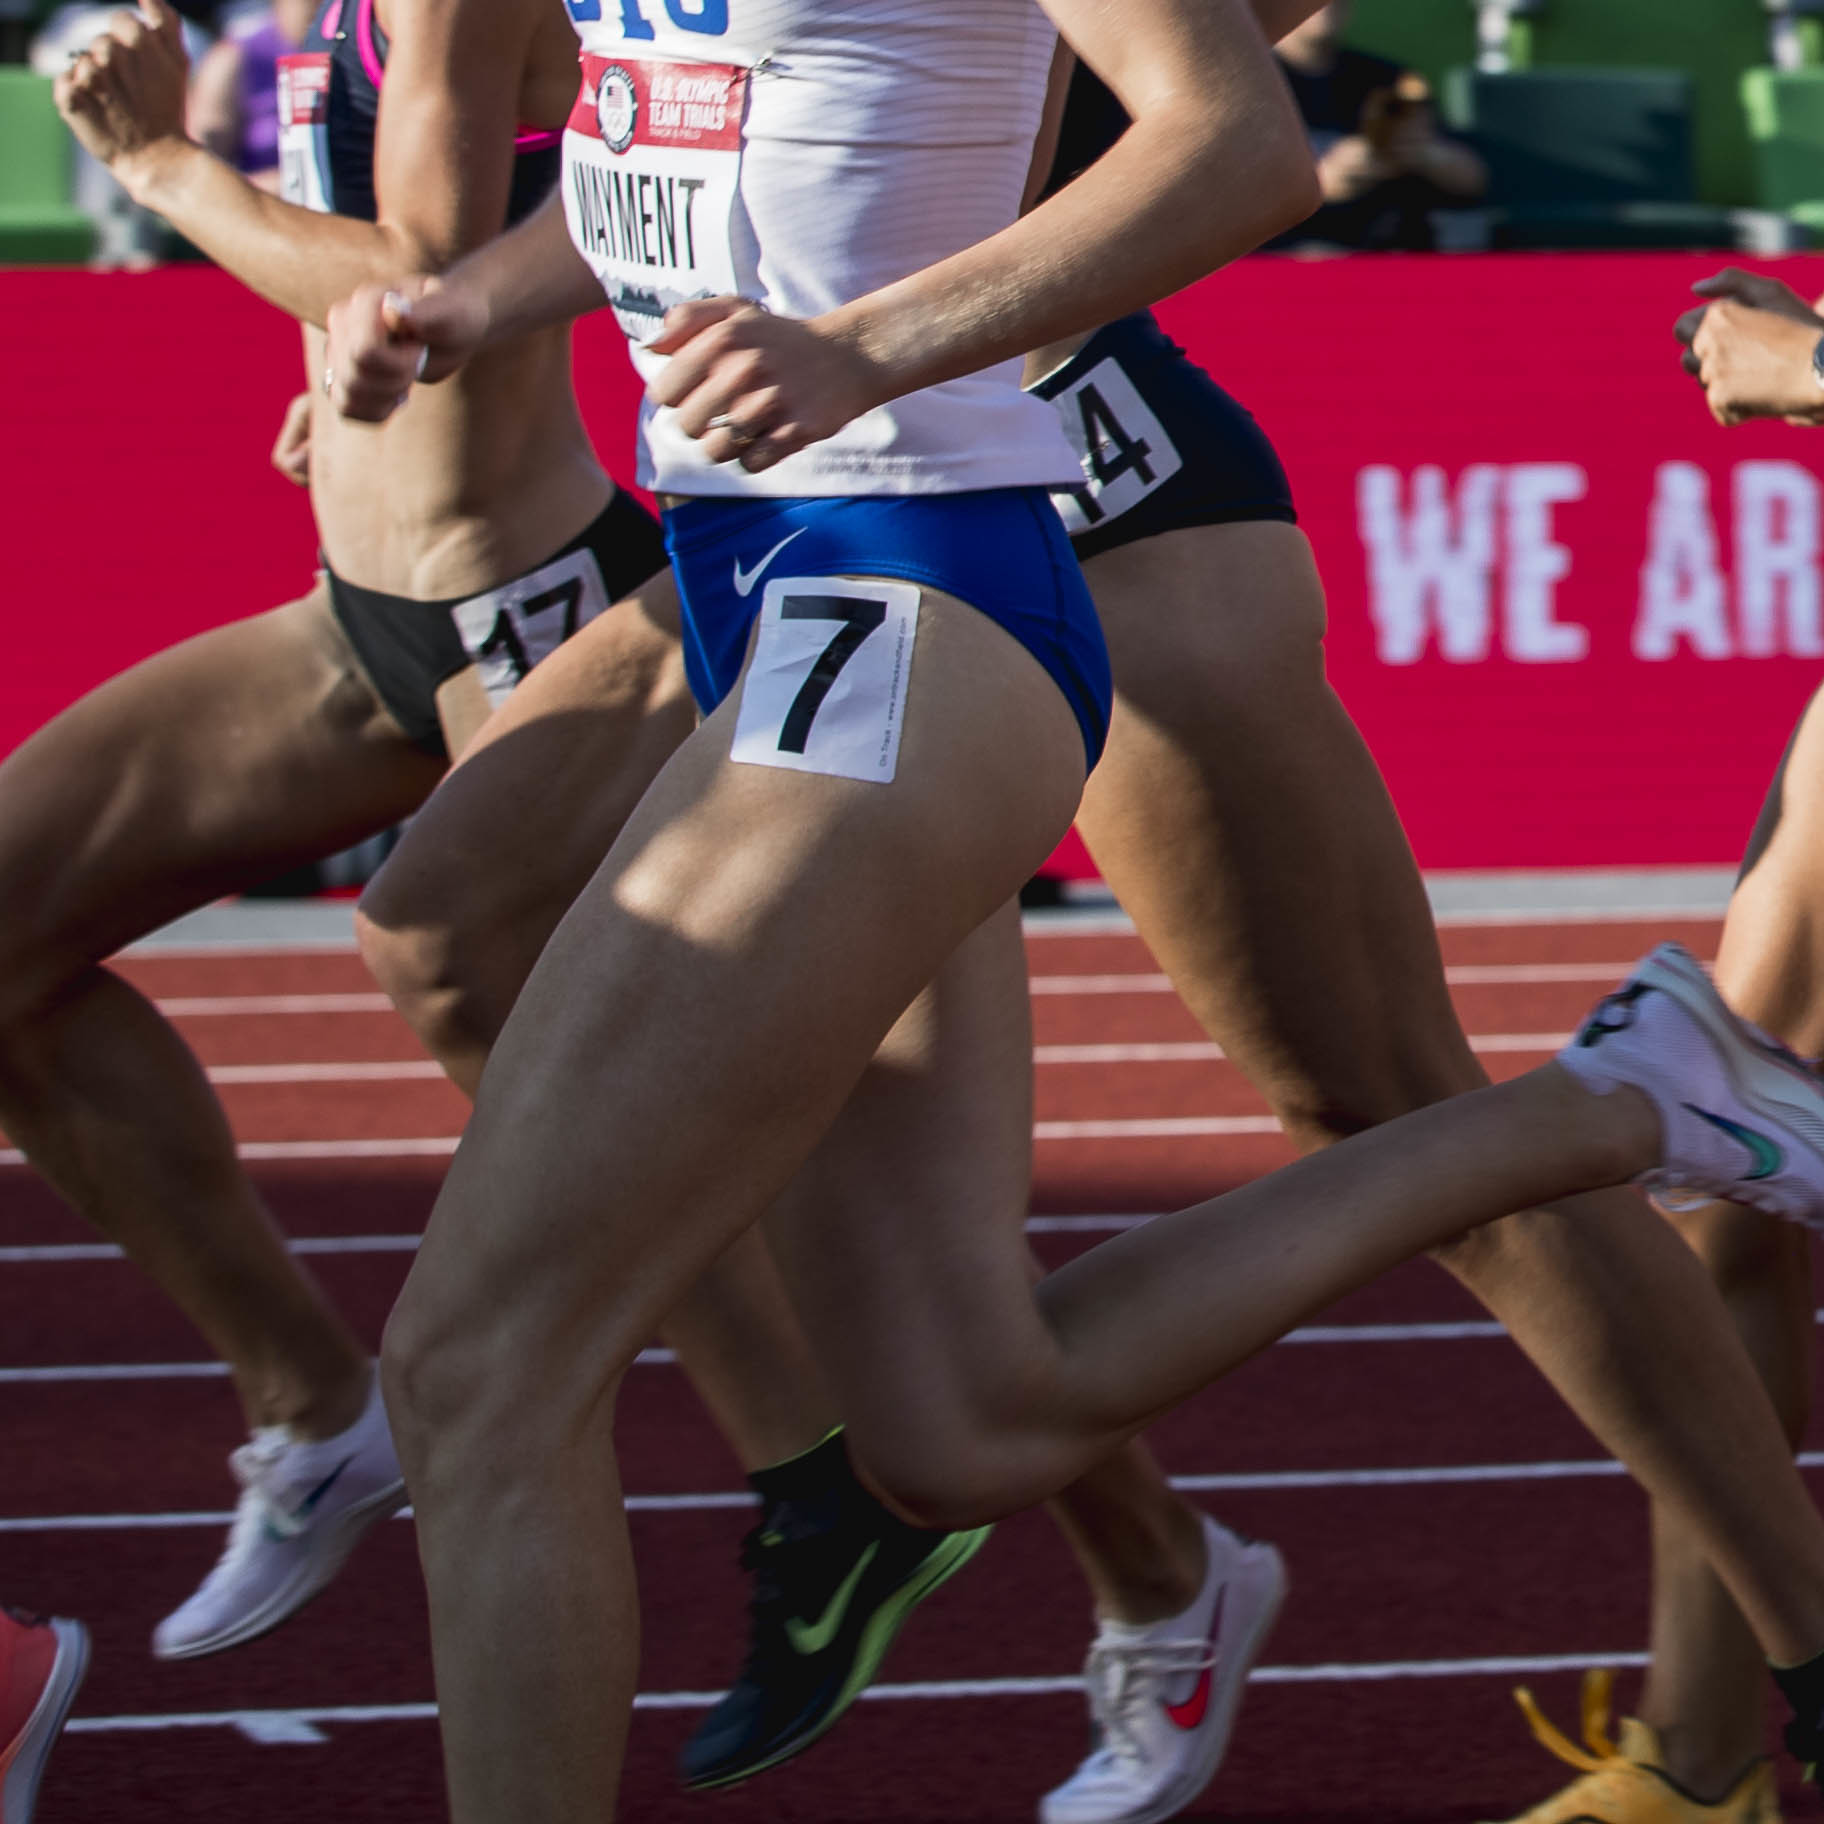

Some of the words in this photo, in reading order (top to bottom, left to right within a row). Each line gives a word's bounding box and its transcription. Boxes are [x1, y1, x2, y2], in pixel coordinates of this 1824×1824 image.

[572, 160, 706, 270] WAYMENT
[479, 576, 584, 679] 17
[1356, 462, 1590, 665] WE
[776, 594, 888, 755] 7
